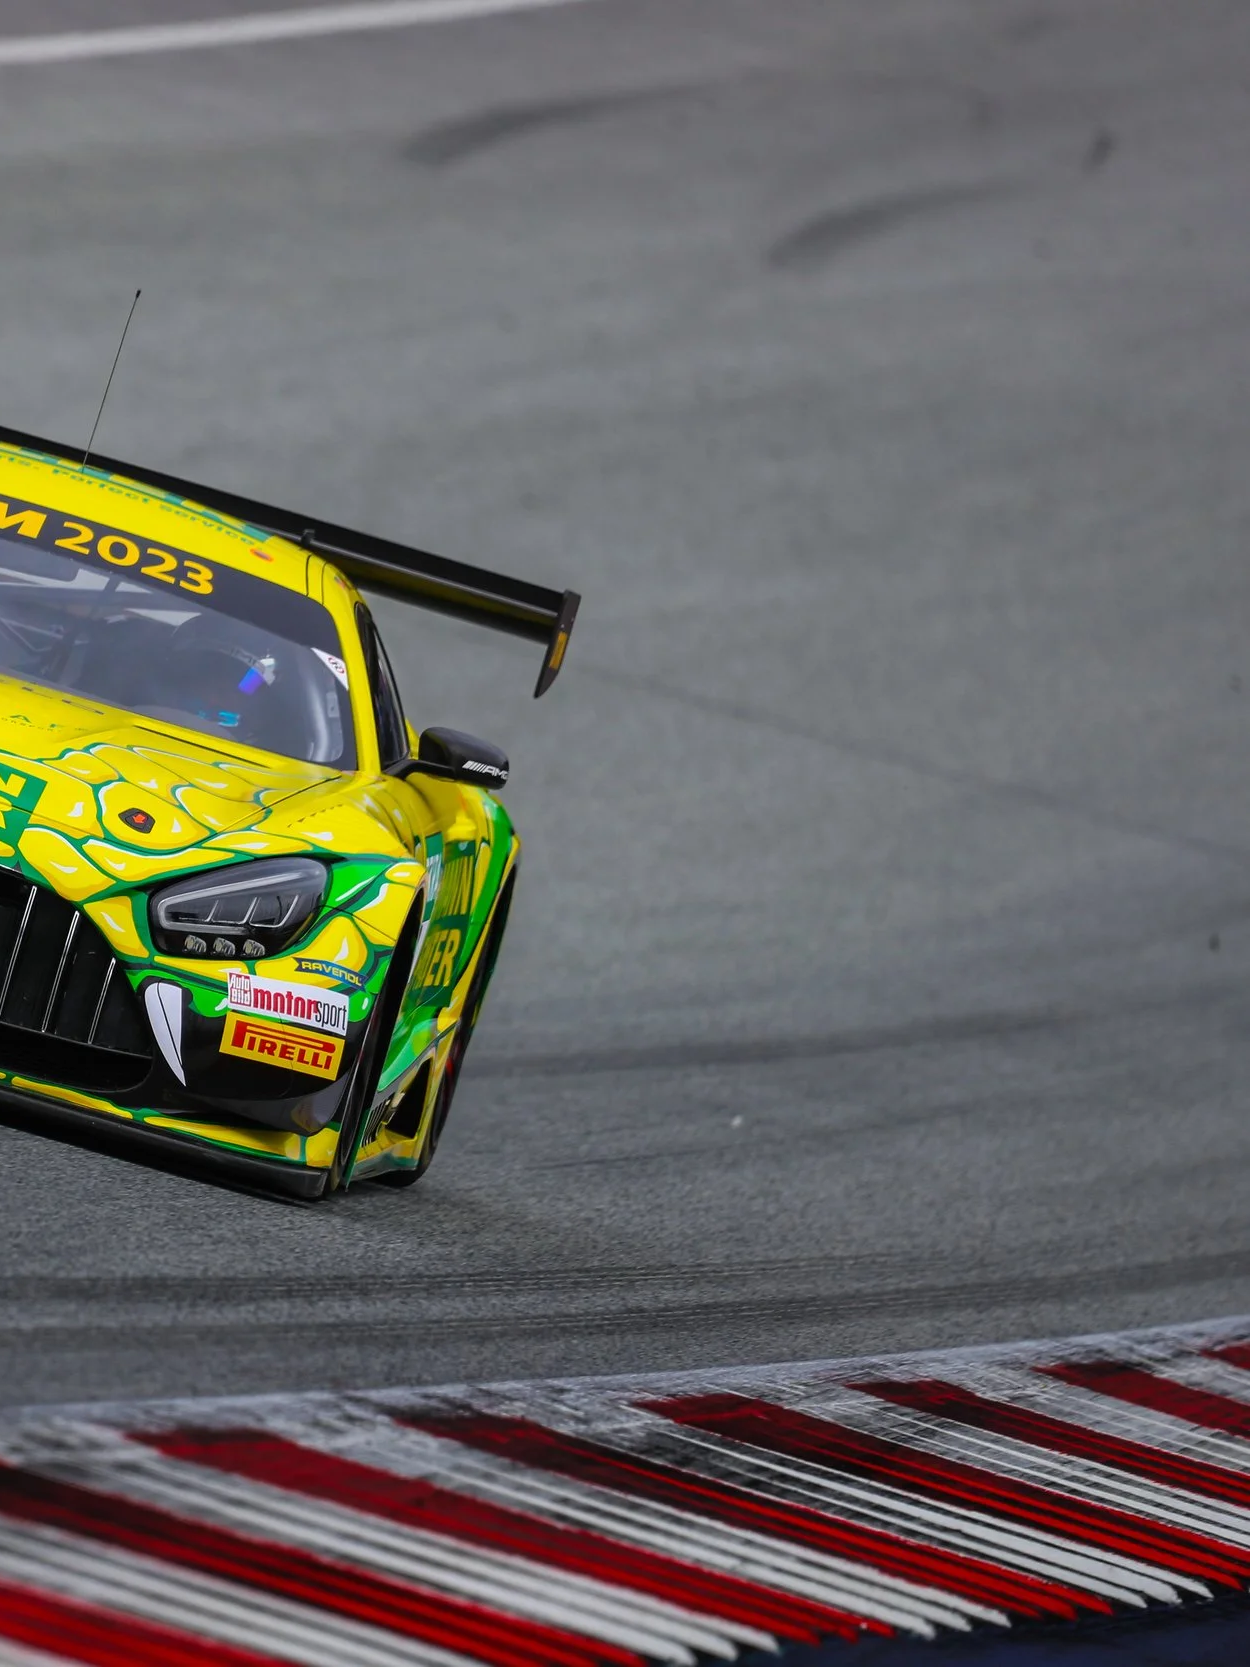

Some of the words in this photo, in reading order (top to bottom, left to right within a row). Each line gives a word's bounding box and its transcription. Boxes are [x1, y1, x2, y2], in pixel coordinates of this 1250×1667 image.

[54, 521, 214, 595] 2023
[229, 974, 250, 990] Auto
[301, 960, 363, 987] RAVENOL
[230, 988, 250, 1005] Bild
[231, 1019, 336, 1070] PIRELLI
